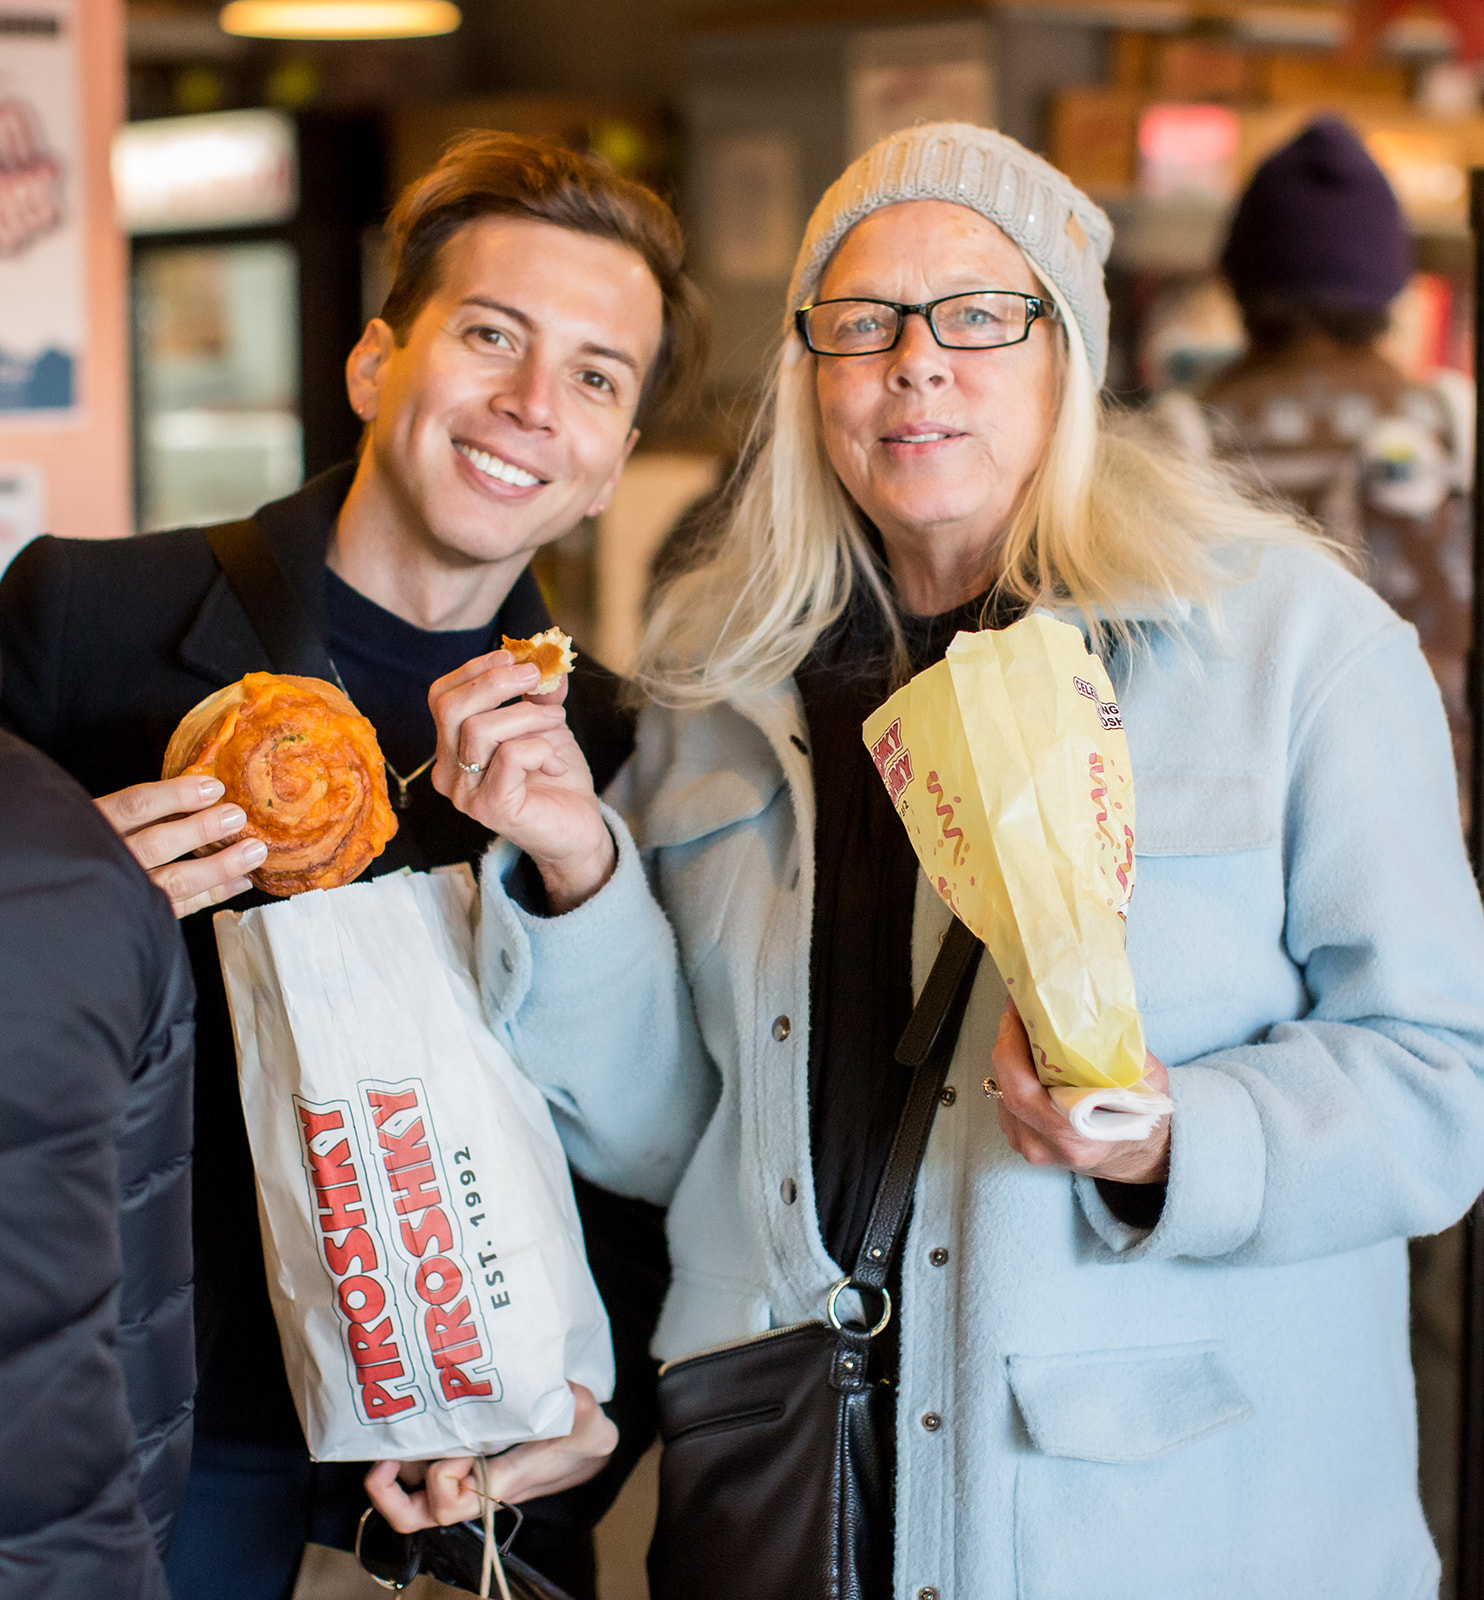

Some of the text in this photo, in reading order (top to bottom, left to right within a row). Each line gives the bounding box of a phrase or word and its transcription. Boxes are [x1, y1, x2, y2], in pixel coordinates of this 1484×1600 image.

[1101, 704, 1120, 716] NG
[297, 1104, 417, 1420] PIROSHKY
[365, 1087, 493, 1403] PIROSHKY
[453, 1146, 512, 1311] EST. 1992
